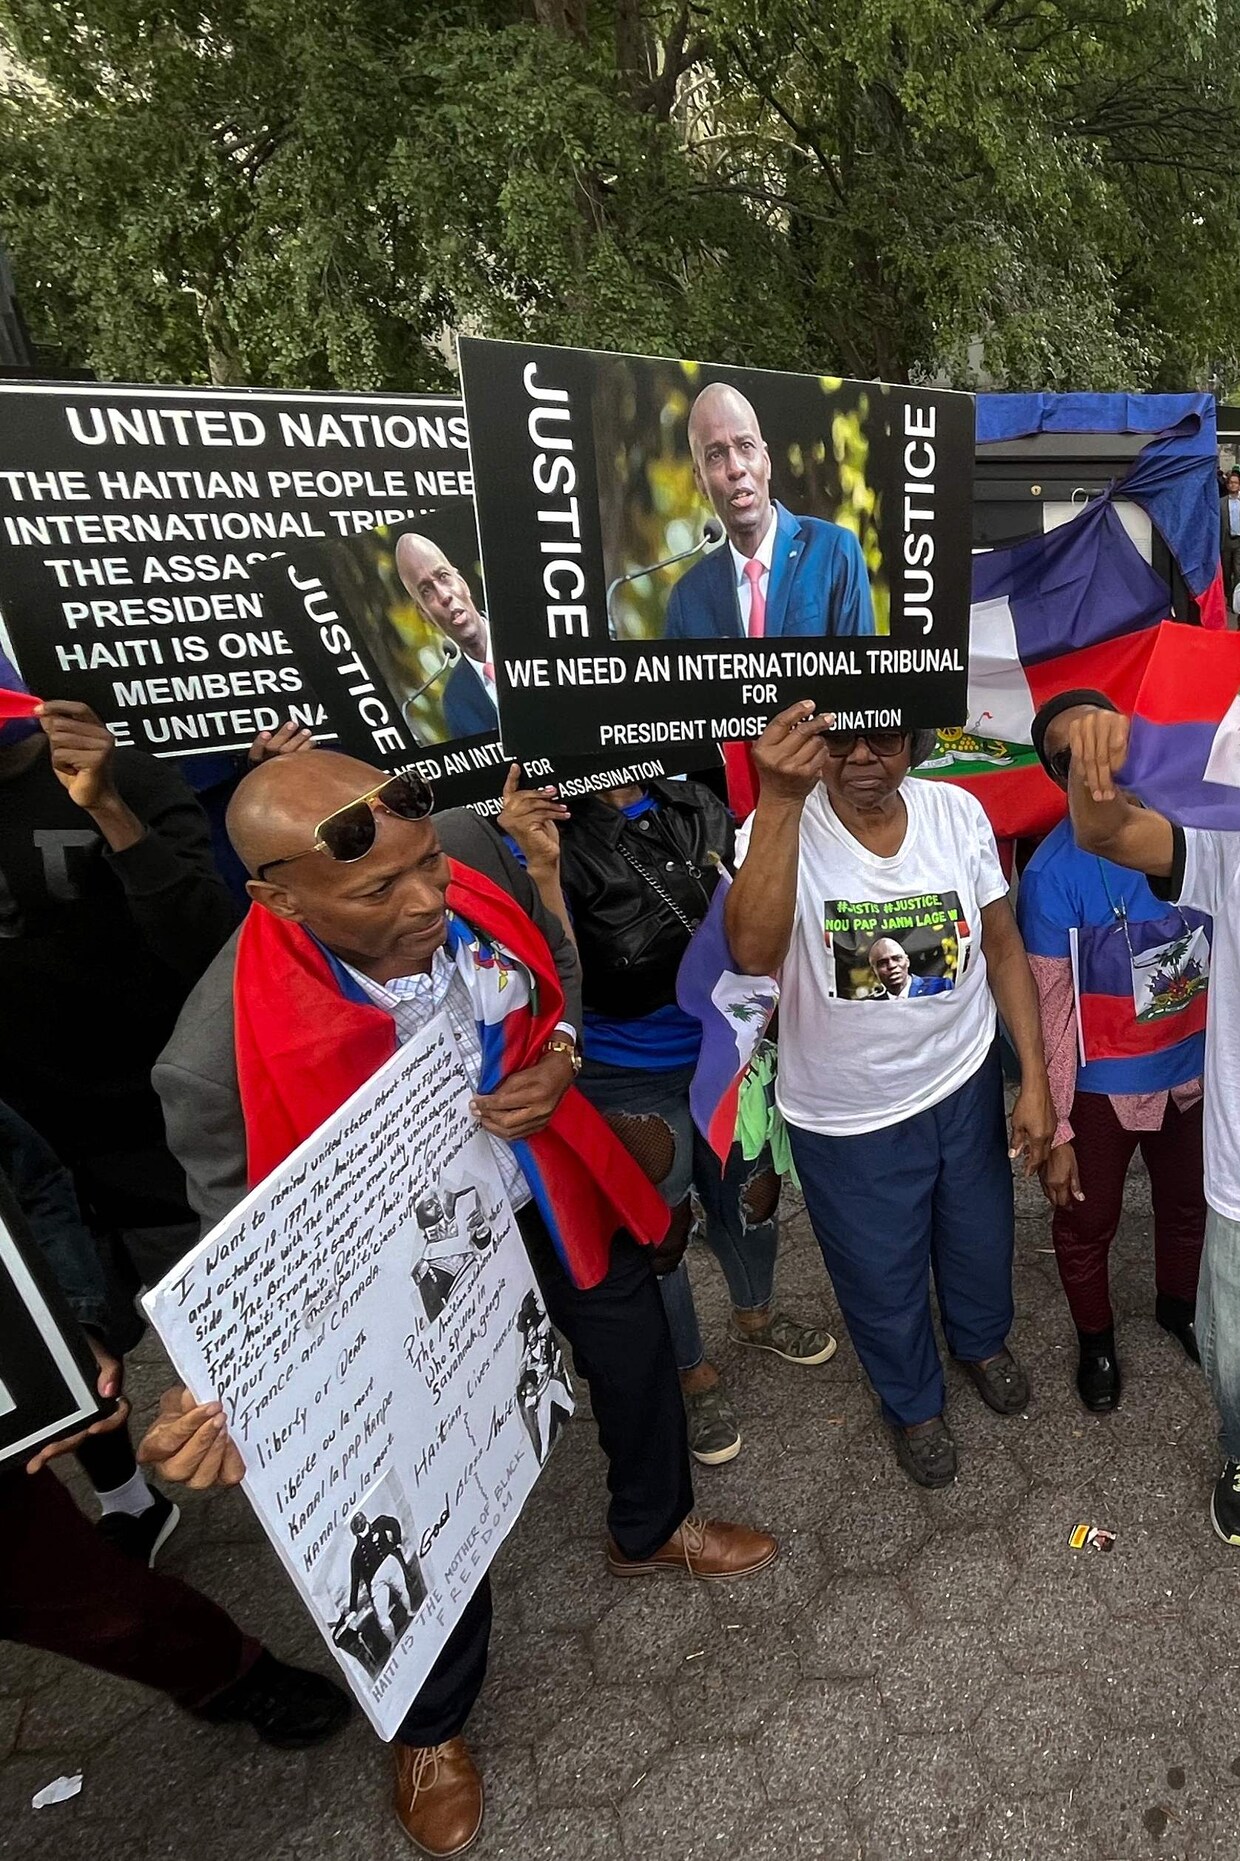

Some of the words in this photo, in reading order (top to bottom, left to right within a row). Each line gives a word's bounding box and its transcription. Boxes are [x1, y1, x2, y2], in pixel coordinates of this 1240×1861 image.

[65, 407, 267, 447] UNITED
[278, 413, 470, 449] NATIONS
[2, 471, 91, 502] THE
[100, 470, 260, 501] HAITIAN
[268, 470, 408, 499] PEOPLE
[523, 361, 590, 640] JUSTICE
[4, 510, 326, 546] INTERNATIONAL
[903, 403, 938, 636] JUSTICE
[43, 556, 131, 588] THE
[61, 592, 264, 630] PRESIDEN
[55, 639, 163, 672] HAITI
[171, 636, 208, 662] IS
[218, 629, 293, 658] ONE
[287, 565, 407, 755] JUSTICE
[505, 657, 550, 689] WE
[556, 655, 628, 688] NEED
[634, 654, 671, 684] AN
[677, 650, 862, 681] INTERNATIONAL
[866, 648, 965, 675] TRIBUNAL
[112, 667, 303, 708] MEMBERS
[742, 684, 778, 705] FOR
[143, 707, 279, 743] UNITED
[600, 718, 706, 746] PRESIDENT
[711, 716, 768, 738] MOISE
[445, 752, 469, 776] AN
[523, 758, 554, 778] FOR
[558, 759, 665, 799] ASSASSINATION
[825, 919, 850, 932] NOU
[854, 919, 877, 931] PAP
[916, 911, 947, 927] LAGE
[948, 909, 958, 921] W
